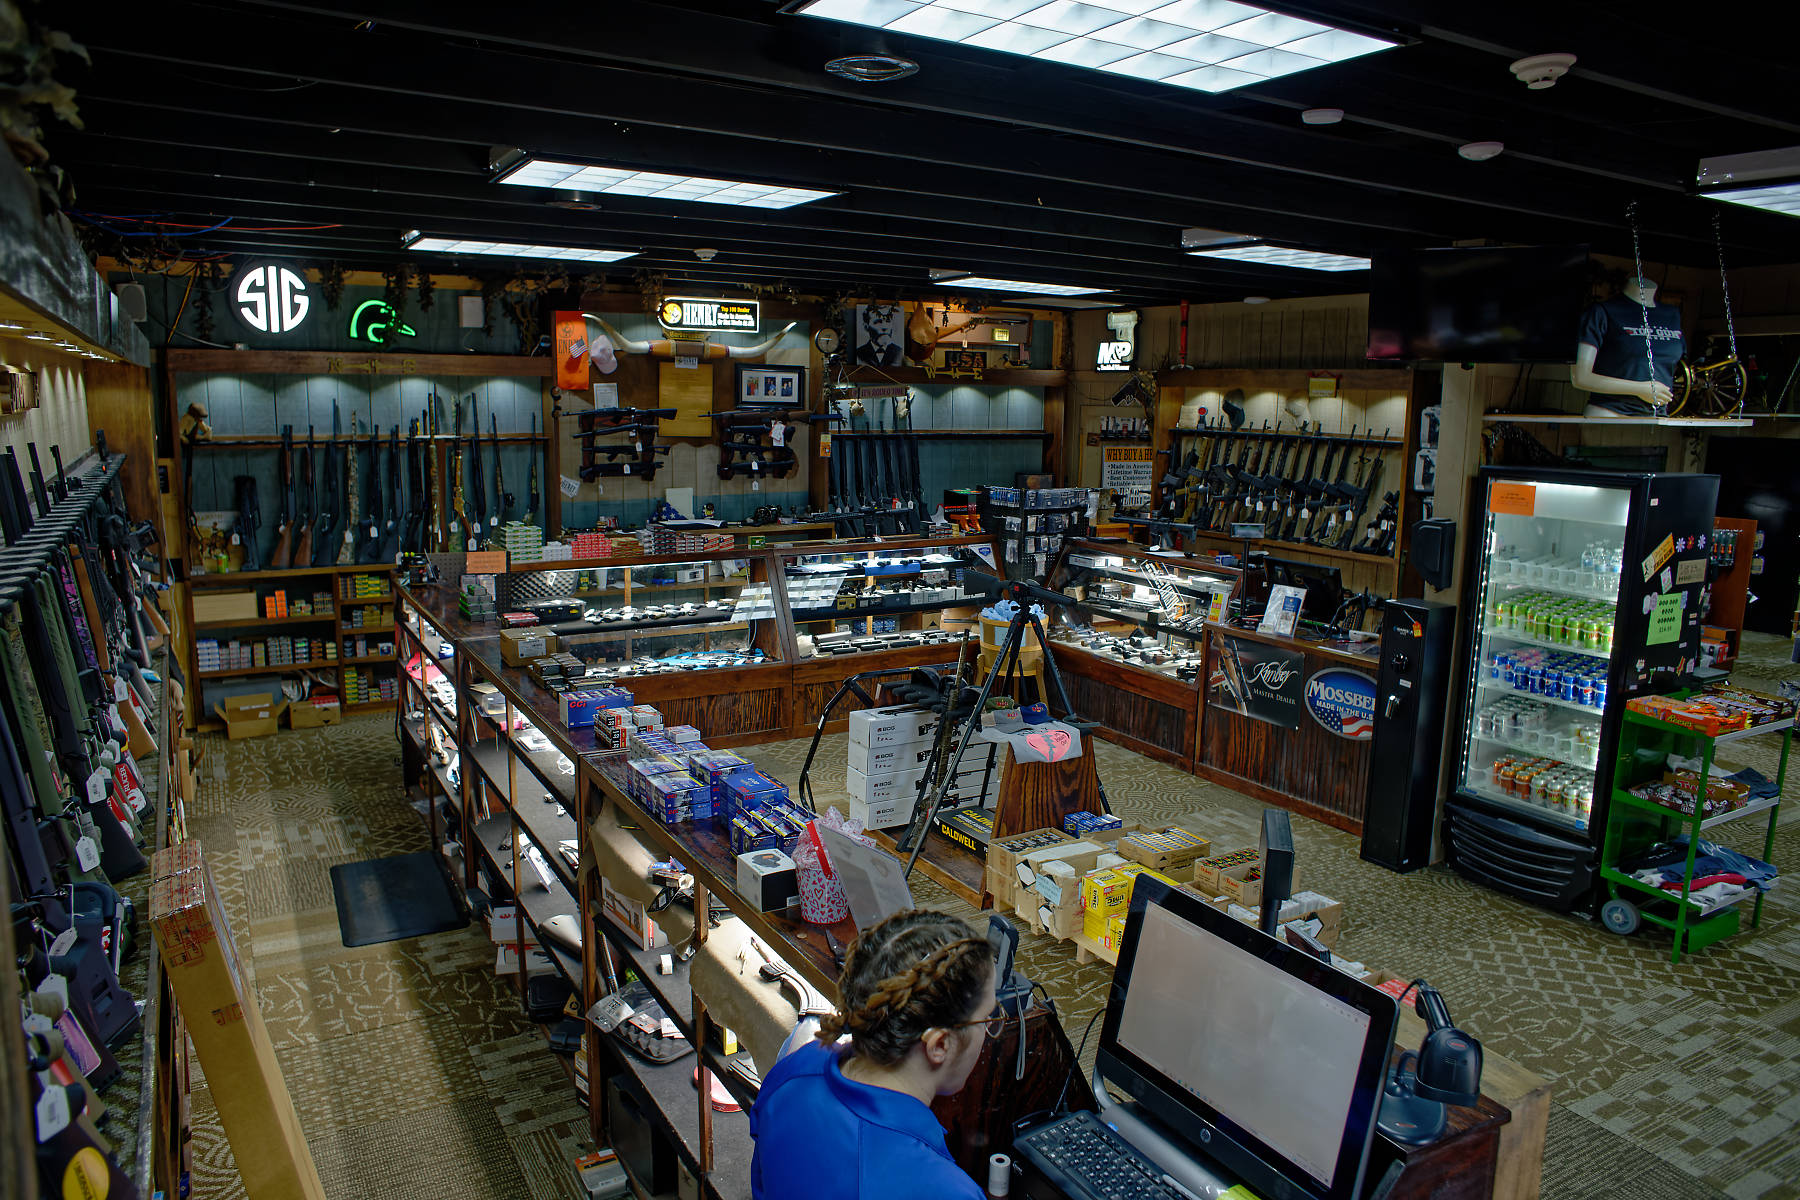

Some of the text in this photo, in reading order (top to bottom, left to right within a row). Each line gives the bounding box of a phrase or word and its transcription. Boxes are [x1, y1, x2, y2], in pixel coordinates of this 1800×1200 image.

[238, 266, 309, 333] SIG
[682, 303, 720, 326] HENRY
[1097, 342, 1131, 364] M&P
[1106, 448, 1122, 461] WHY
[1123, 448, 1138, 461] BUY
[1138, 448, 1143, 461] A
[1247, 660, 1299, 690] Kimber
[1253, 688, 1296, 705] MASTER DEALER
[1316, 700, 1336, 711] MADE
[1336, 705, 1344, 713] IN
[1345, 708, 1360, 717] THE
[119, 765, 130, 793] RUGER
[1676, 779, 1715, 797] TWX
[941, 824, 977, 851] CALDWELL
